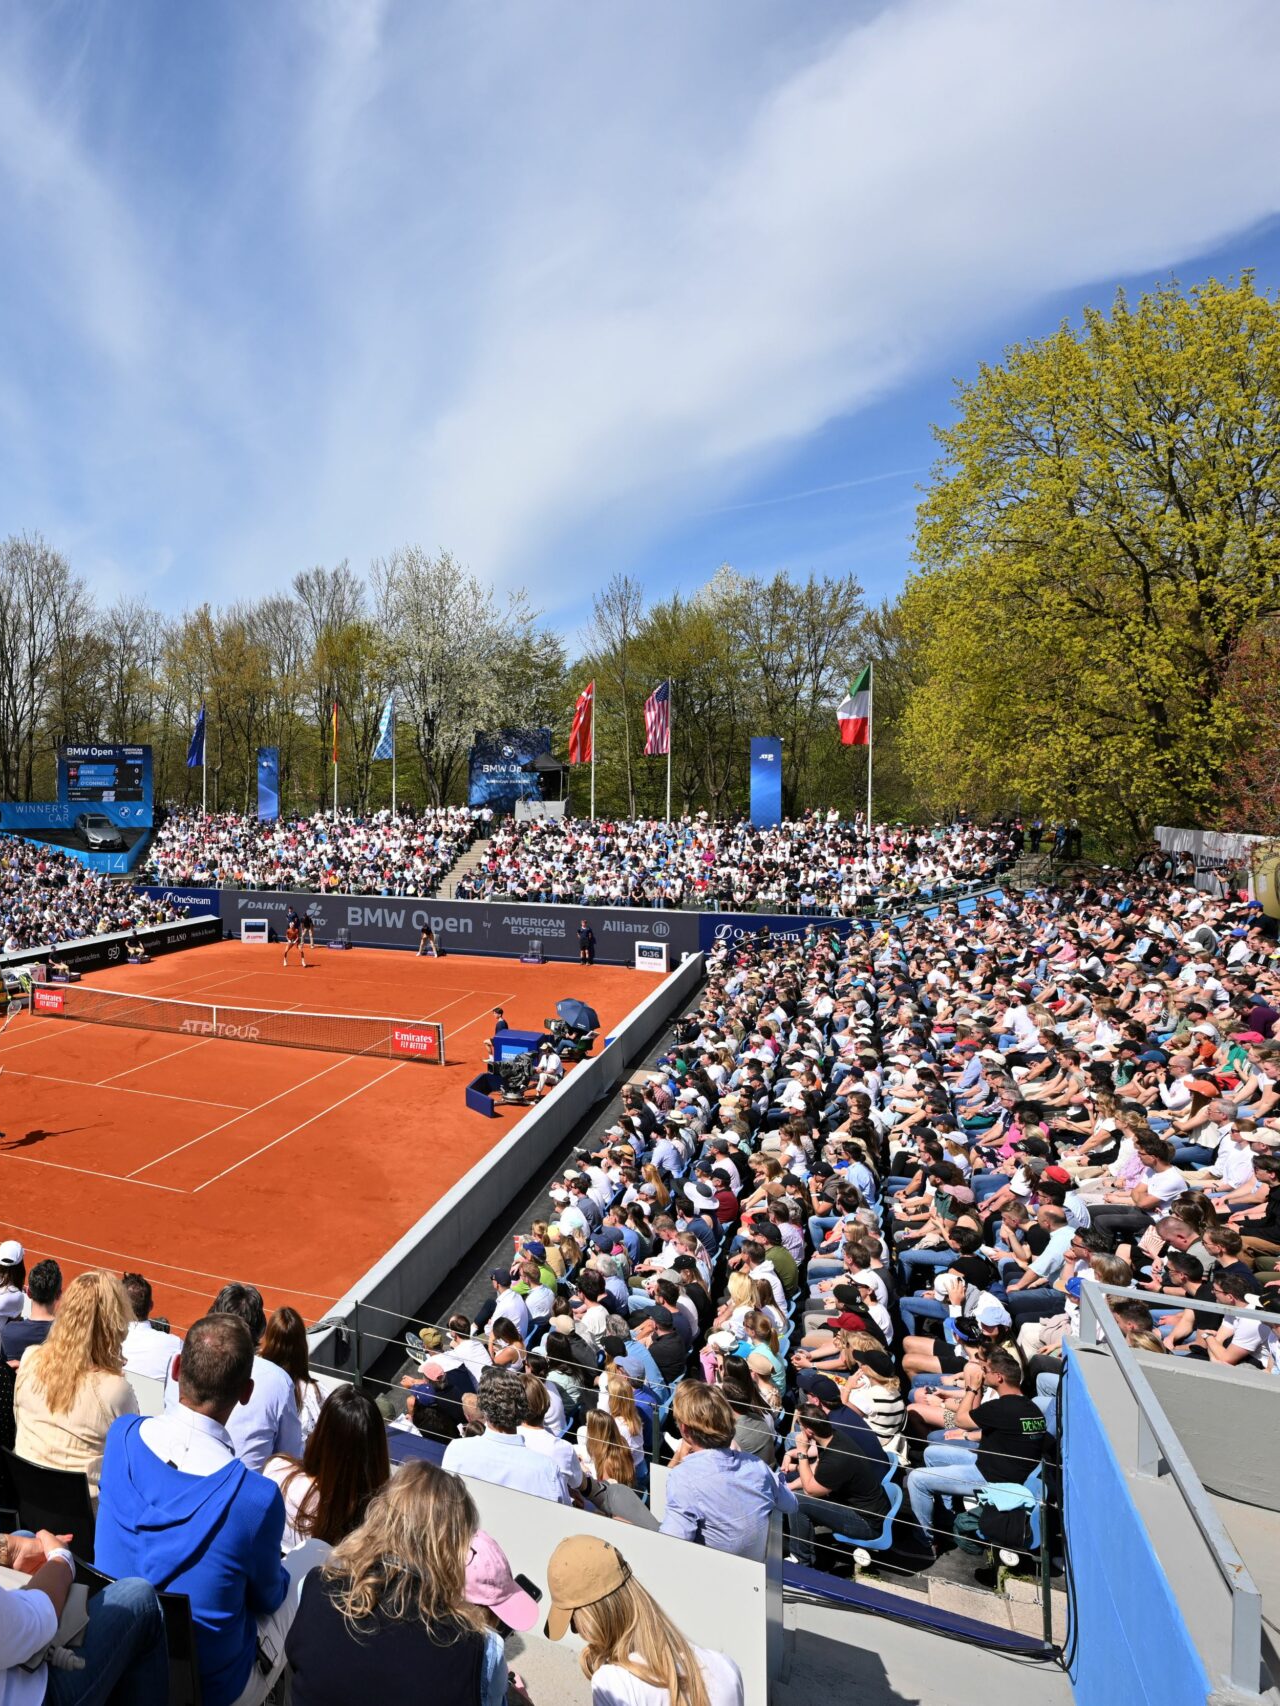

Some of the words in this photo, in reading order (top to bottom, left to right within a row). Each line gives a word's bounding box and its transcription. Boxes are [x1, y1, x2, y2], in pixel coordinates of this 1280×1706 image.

[66, 747, 89, 756] BMW
[91, 747, 113, 757] Open
[482, 764, 507, 773] BMW
[509, 764, 522, 773] Op
[15, 804, 69, 814] WINNER'S
[48, 813, 69, 822] CAR
[107, 854, 125, 872] i4
[173, 894, 211, 905] OneStream
[247, 901, 287, 911] DAIKIN
[347, 906, 406, 929] BMW
[411, 910, 473, 934] Open
[482, 921, 492, 929] by
[502, 916, 566, 929] AMERICAN
[511, 926, 567, 938] EXPRESS
[602, 920, 650, 934] Allianz
[167, 933, 187, 944] RILANO
[641, 950, 660, 958] 0:36
[35, 992, 62, 1003] Emirates
[179, 1019, 214, 1035] ATP
[216, 1022, 260, 1041] TOUR
[394, 1031, 433, 1044] Emirates
[400, 1041, 410, 1049] FLY
